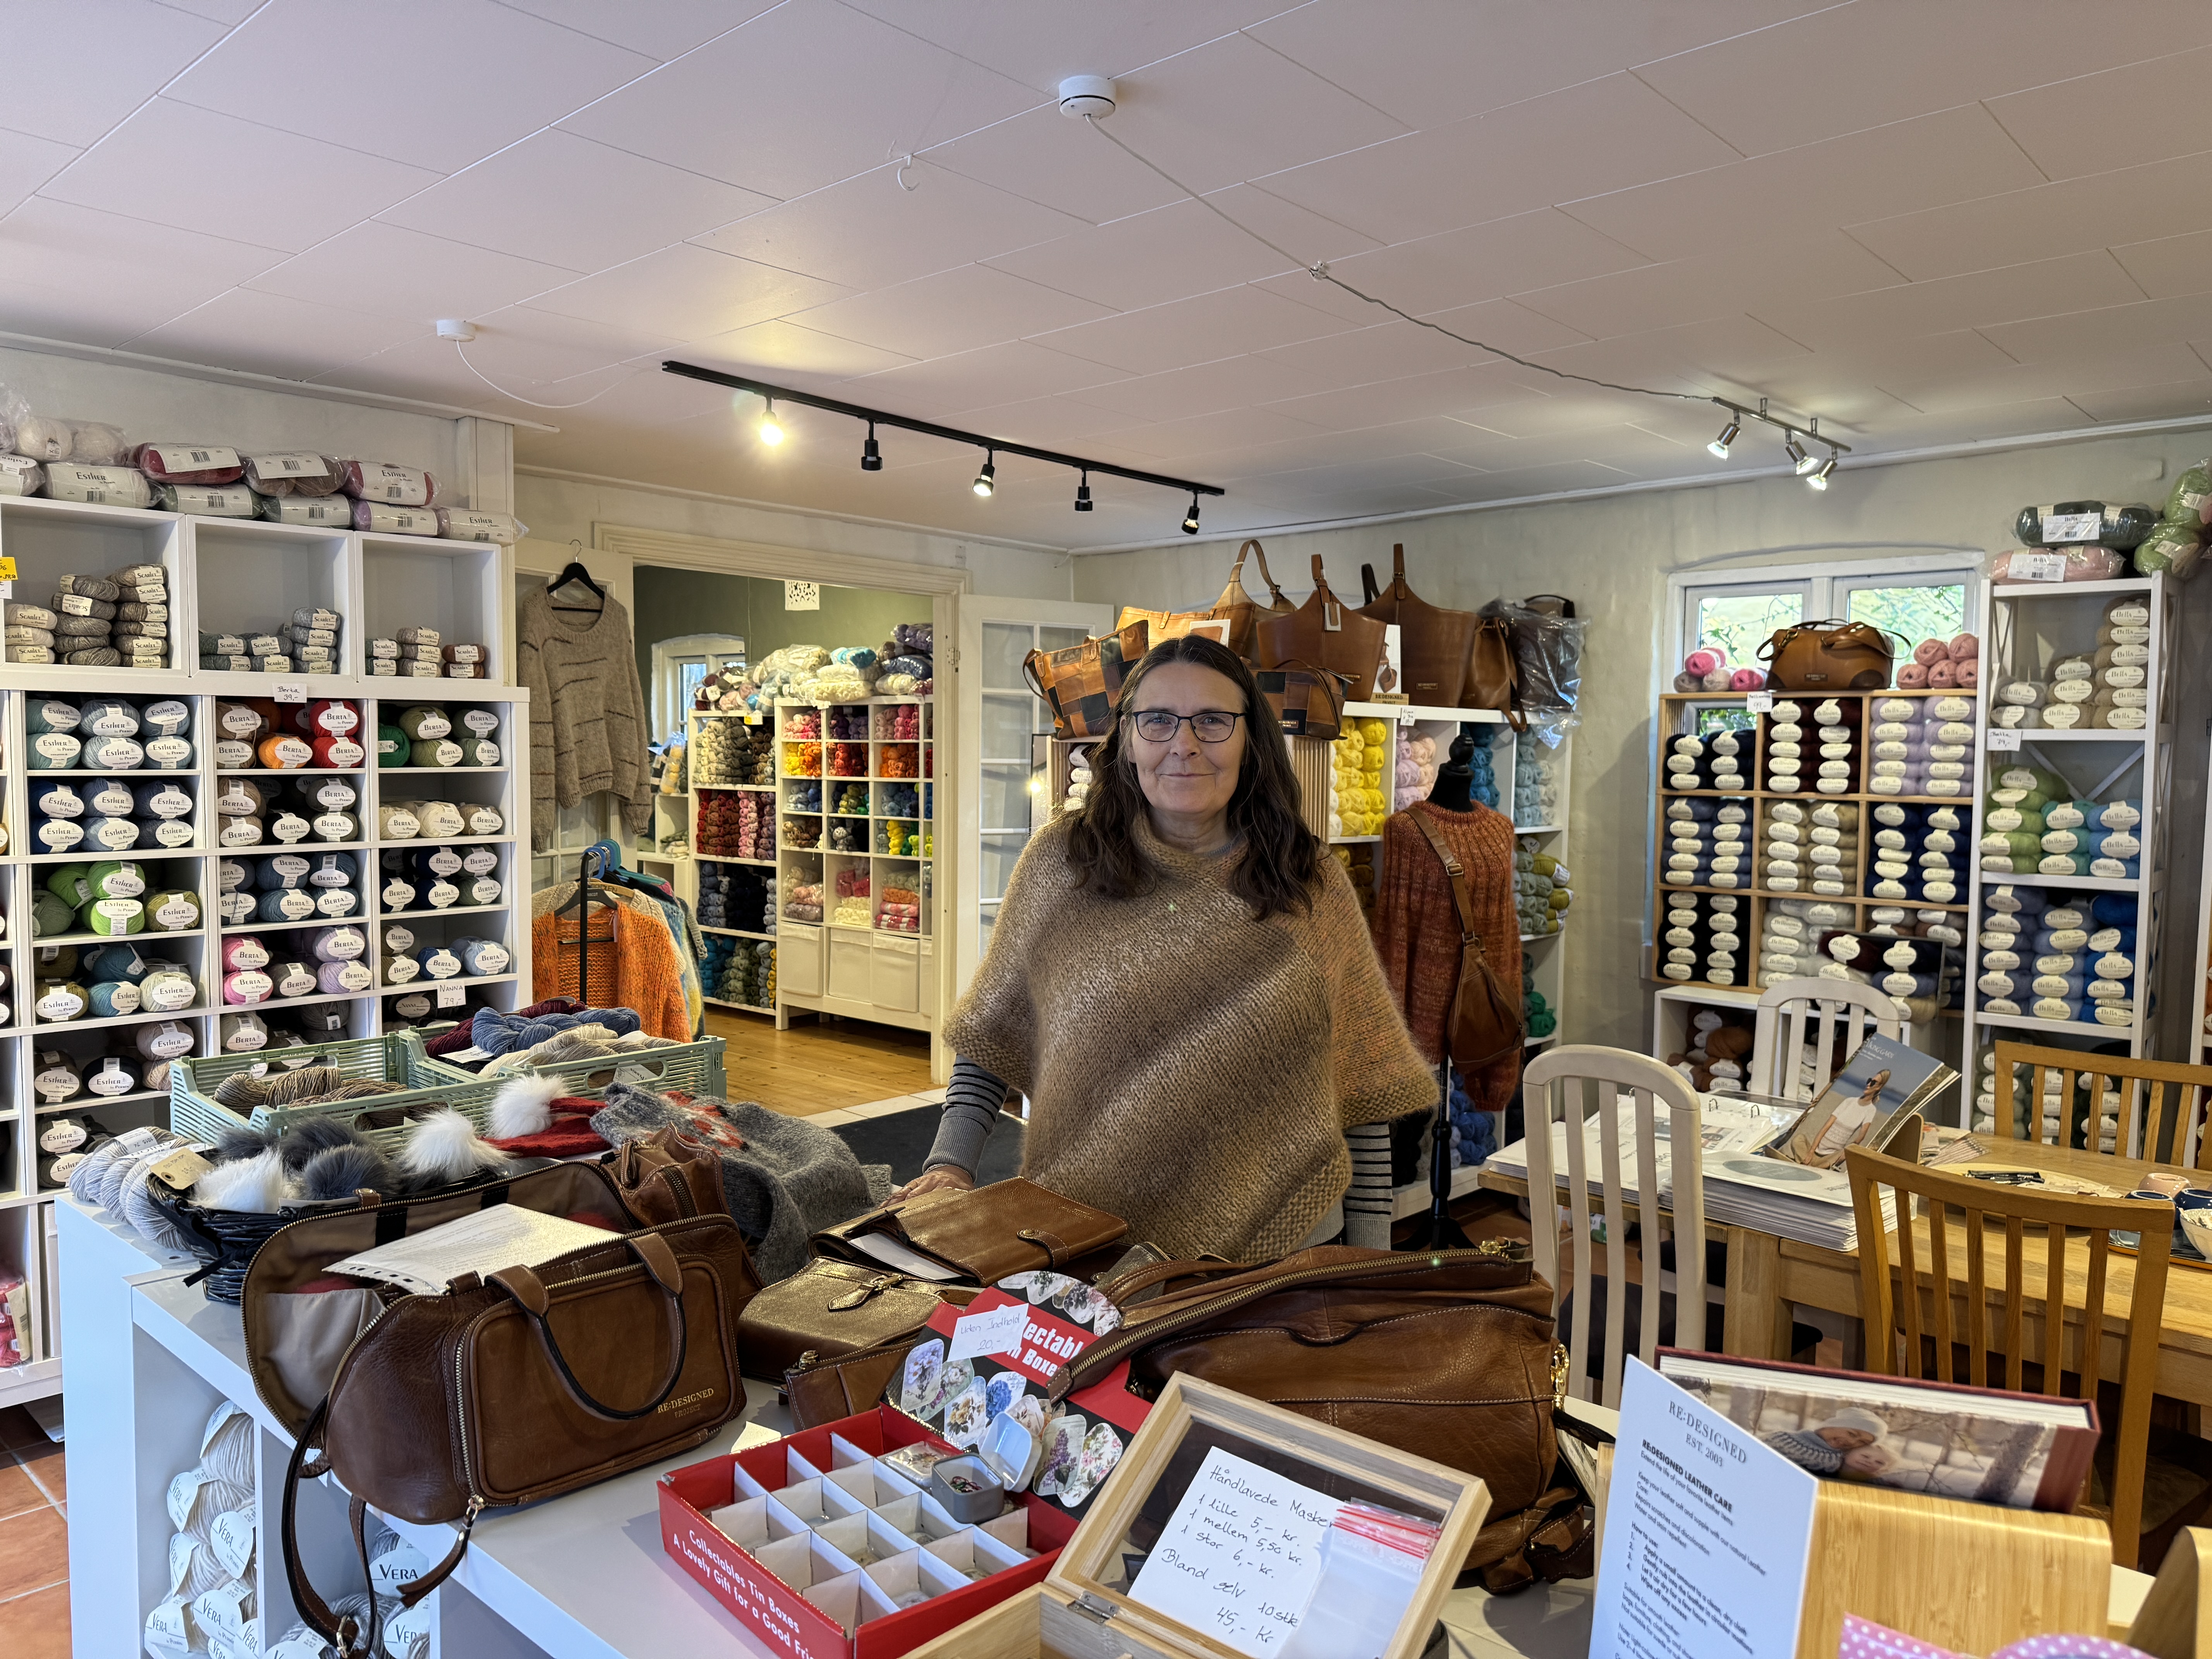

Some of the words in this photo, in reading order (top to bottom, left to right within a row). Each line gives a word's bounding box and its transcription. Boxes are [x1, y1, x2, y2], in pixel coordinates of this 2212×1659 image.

[987, 1313, 1020, 1330] Indhold
[977, 1339, 1001, 1351] 20,-
[658, 1388, 714, 1413] RE:DESIGNED
[675, 1404, 701, 1418] PROJECT
[1669, 1400, 1747, 1463] RE:DESIGNED
[1686, 1433, 1702, 1453] EST.
[1705, 1448, 1723, 1467] 2003
[173, 1479, 182, 1503] VERA
[1210, 1465, 1278, 1507] Håndlavede
[1642, 1439, 1683, 1475] RE:DESIGNED
[1685, 1470, 1712, 1498] LEATHER
[1714, 1493, 1732, 1513] CARE
[218, 1518, 234, 1548] VERA
[1209, 1498, 1238, 1517] lille
[1282, 1529, 1300, 1546] kr.
[1196, 1532, 1223, 1549] stor
[1259, 1563, 1274, 1578] kr.
[1204, 1516, 1247, 1543] mellem
[1288, 1551, 1302, 1566] kr.
[380, 1564, 419, 1580] VERA
[1161, 1548, 1209, 1580] Bland
[674, 1534, 680, 1548] A
[683, 1540, 710, 1578] Lovely
[714, 1569, 731, 1594] Gift
[734, 1586, 748, 1609] for
[752, 1607, 759, 1619] a
[763, 1613, 791, 1647] Good
[689, 1530, 745, 1588] Collectables
[748, 1580, 765, 1605] Tin
[768, 1597, 799, 1633] Boxes
[153, 1613, 167, 1633] VERA
[203, 1598, 221, 1625] VERA
[1217, 1607, 1246, 1634] 45,-
[243, 1625, 257, 1653] VERA
